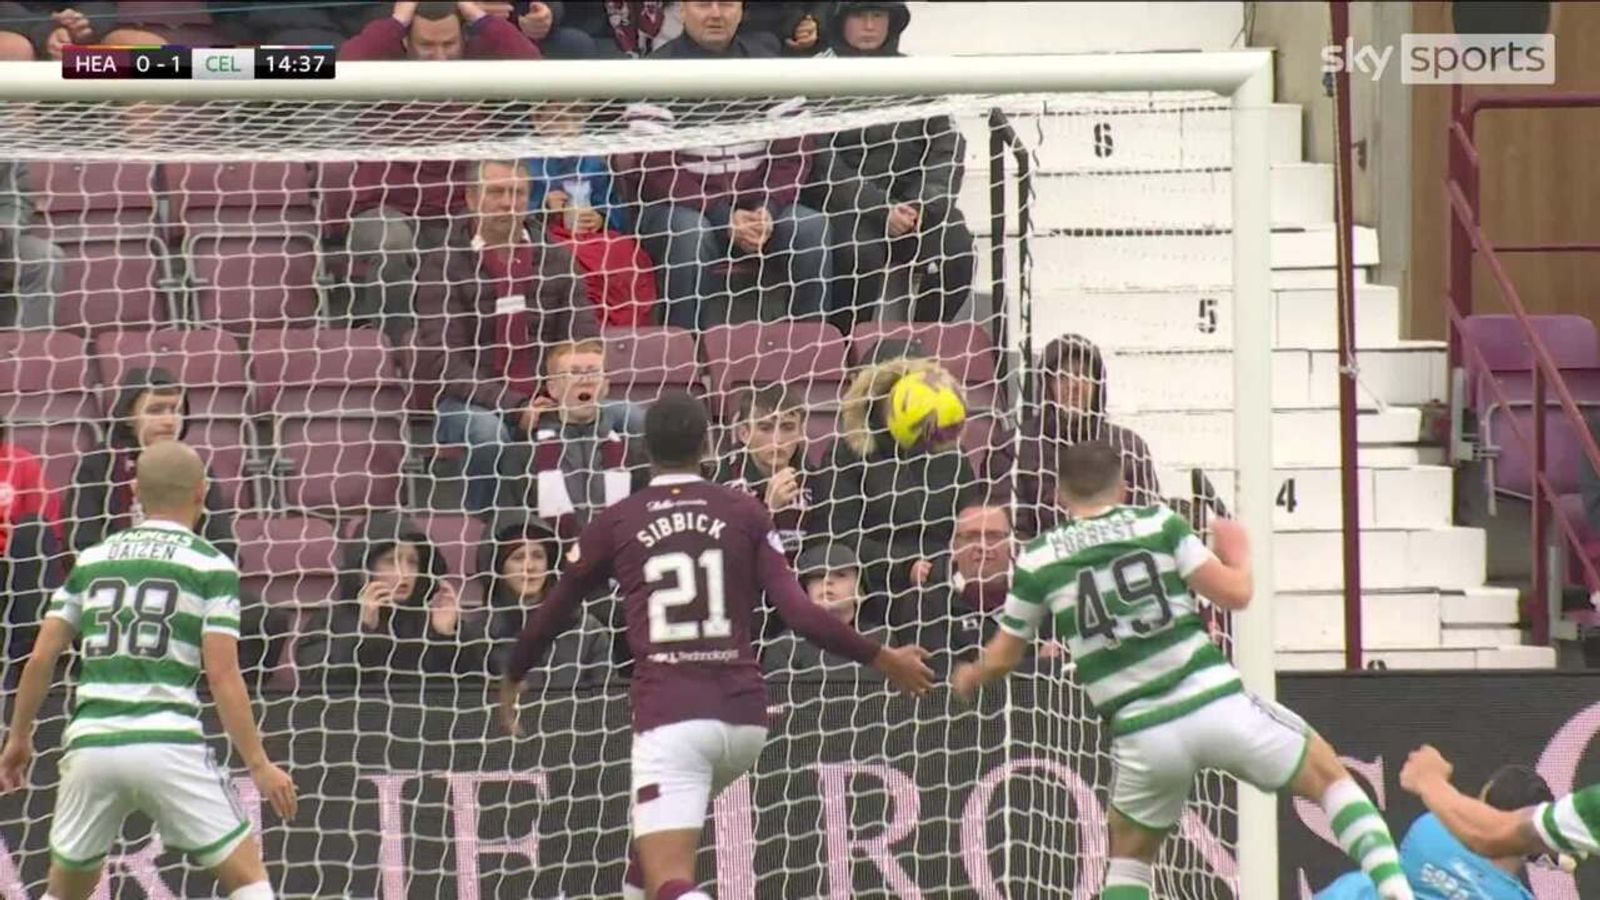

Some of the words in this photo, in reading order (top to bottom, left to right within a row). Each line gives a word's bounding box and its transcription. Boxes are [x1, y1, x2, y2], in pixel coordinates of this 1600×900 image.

[1093, 122, 1114, 158] 6
[1198, 299, 1218, 334] 5
[1275, 478, 1298, 513] 4
[636, 511, 728, 548] SIBBICK
[643, 548, 732, 643] 21
[1075, 549, 1176, 650] 49
[82, 576, 181, 660] 38
